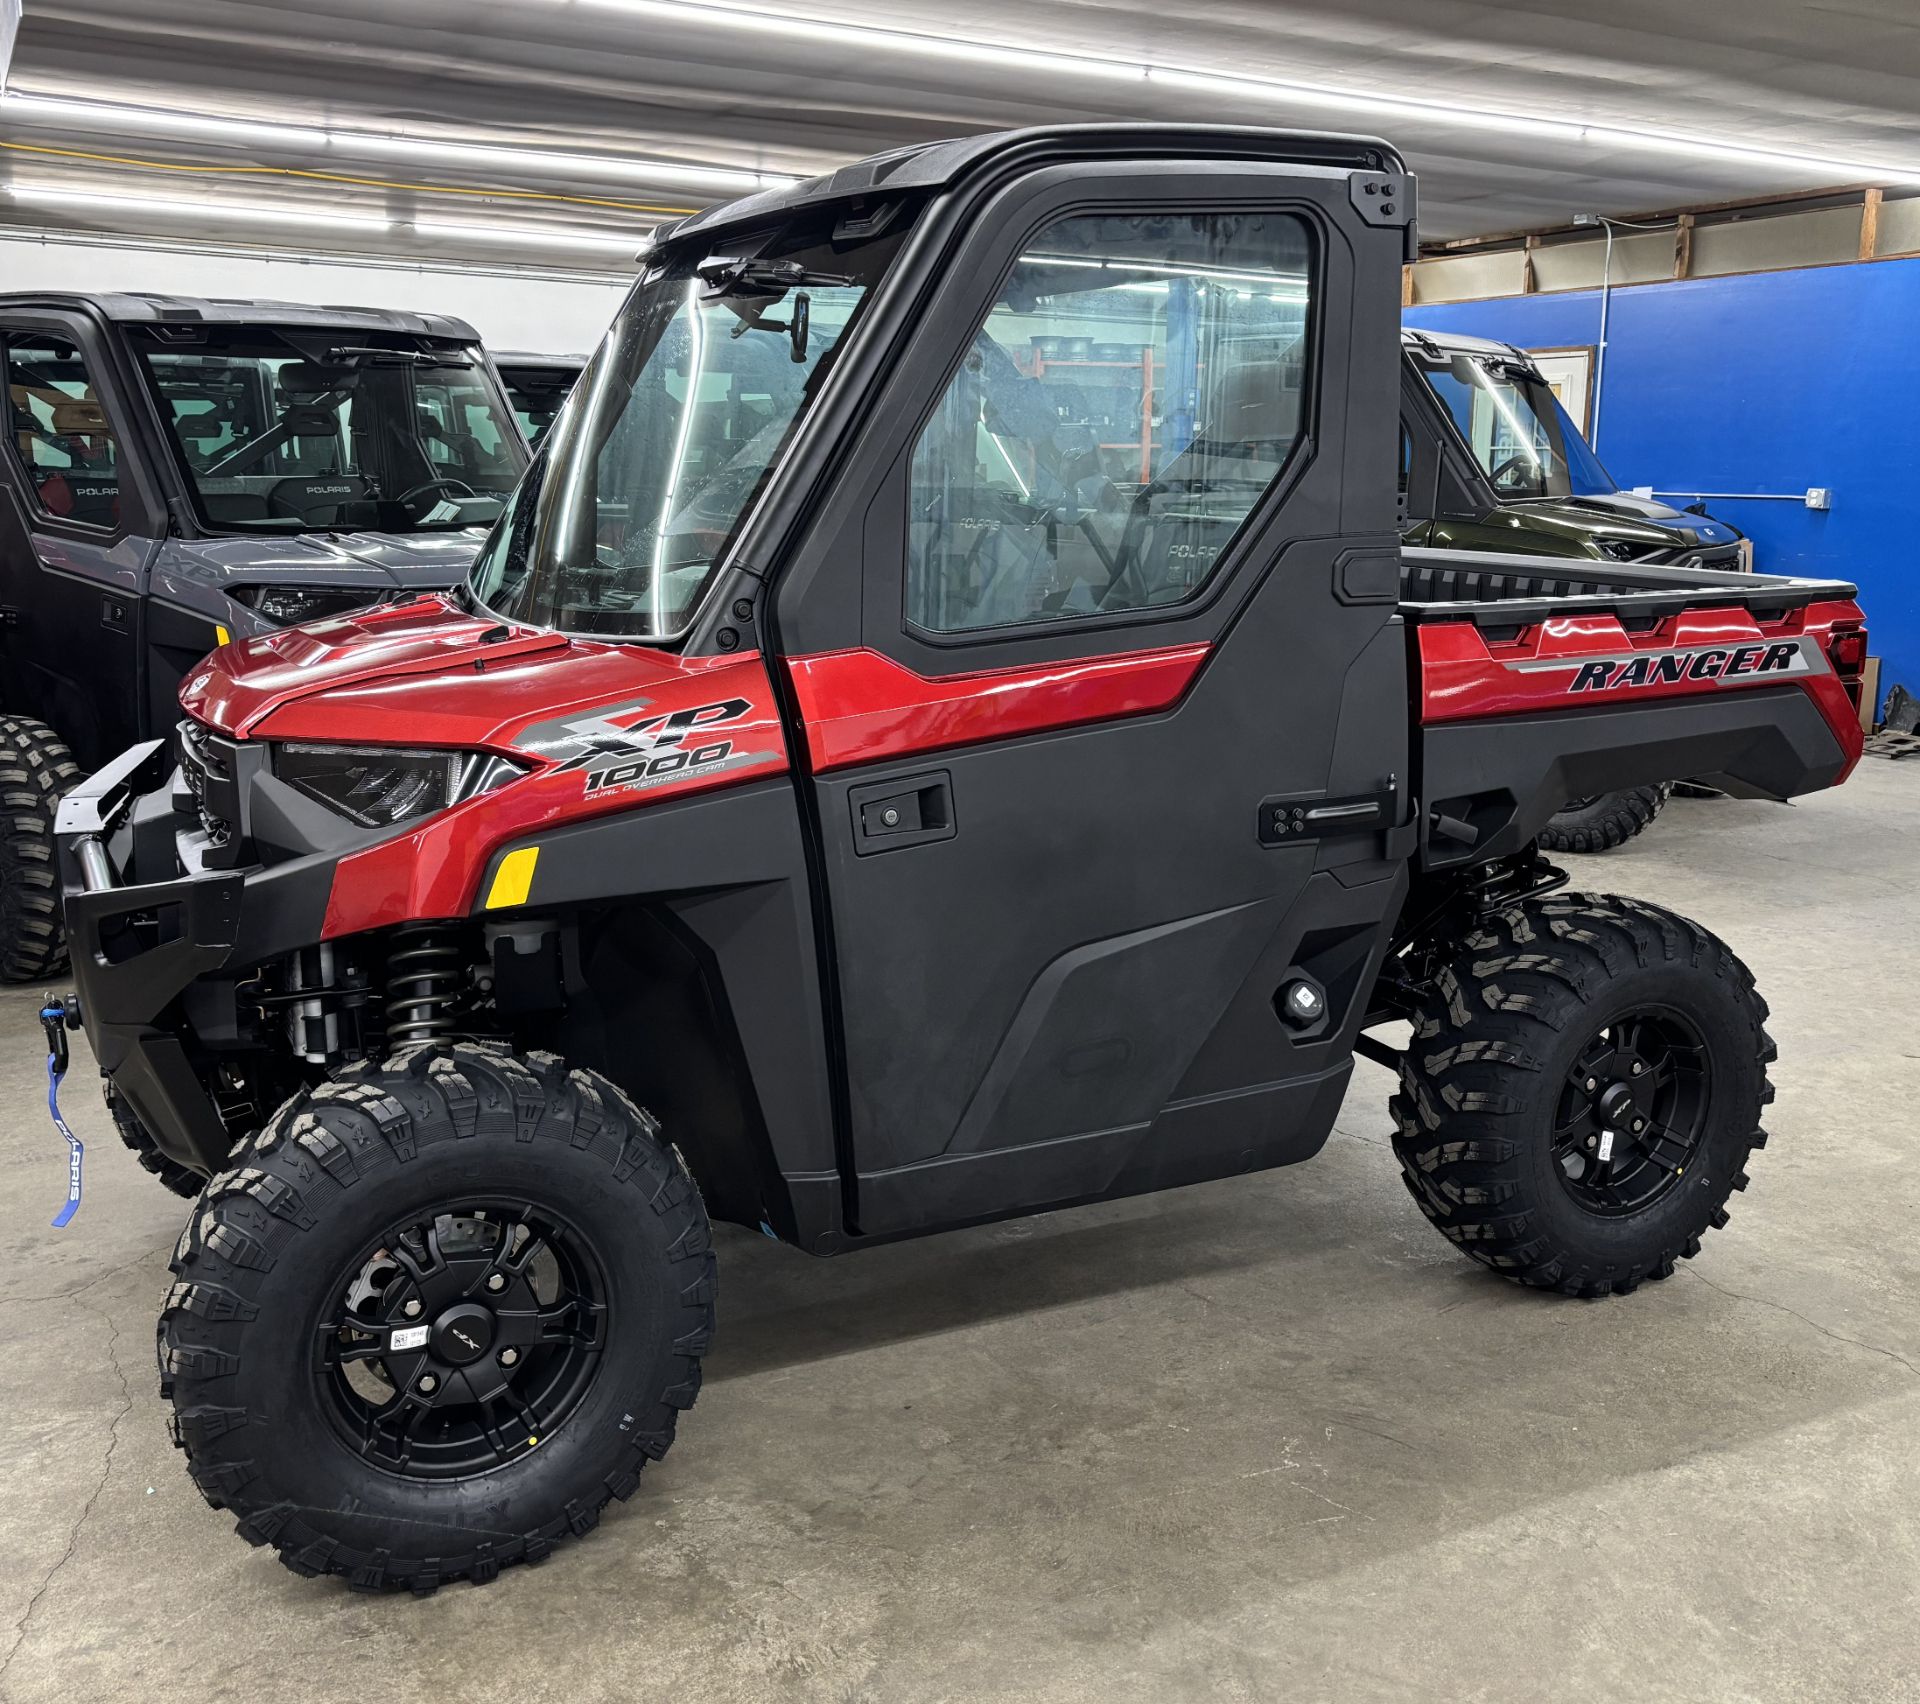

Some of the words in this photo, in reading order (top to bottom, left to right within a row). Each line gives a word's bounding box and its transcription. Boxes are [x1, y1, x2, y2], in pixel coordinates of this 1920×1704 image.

[76, 486, 119, 496] POLAR
[305, 485, 352, 495] POLARIS
[1567, 642, 1800, 693] RANGER
[548, 697, 753, 777] XP
[583, 740, 733, 793] 1000
[584, 788, 619, 801] DUAL
[622, 770, 694, 792] OVERHEAD
[696, 762, 726, 775] CAM
[54, 1118, 82, 1202] POLARIS
[452, 1328, 481, 1350] XP
